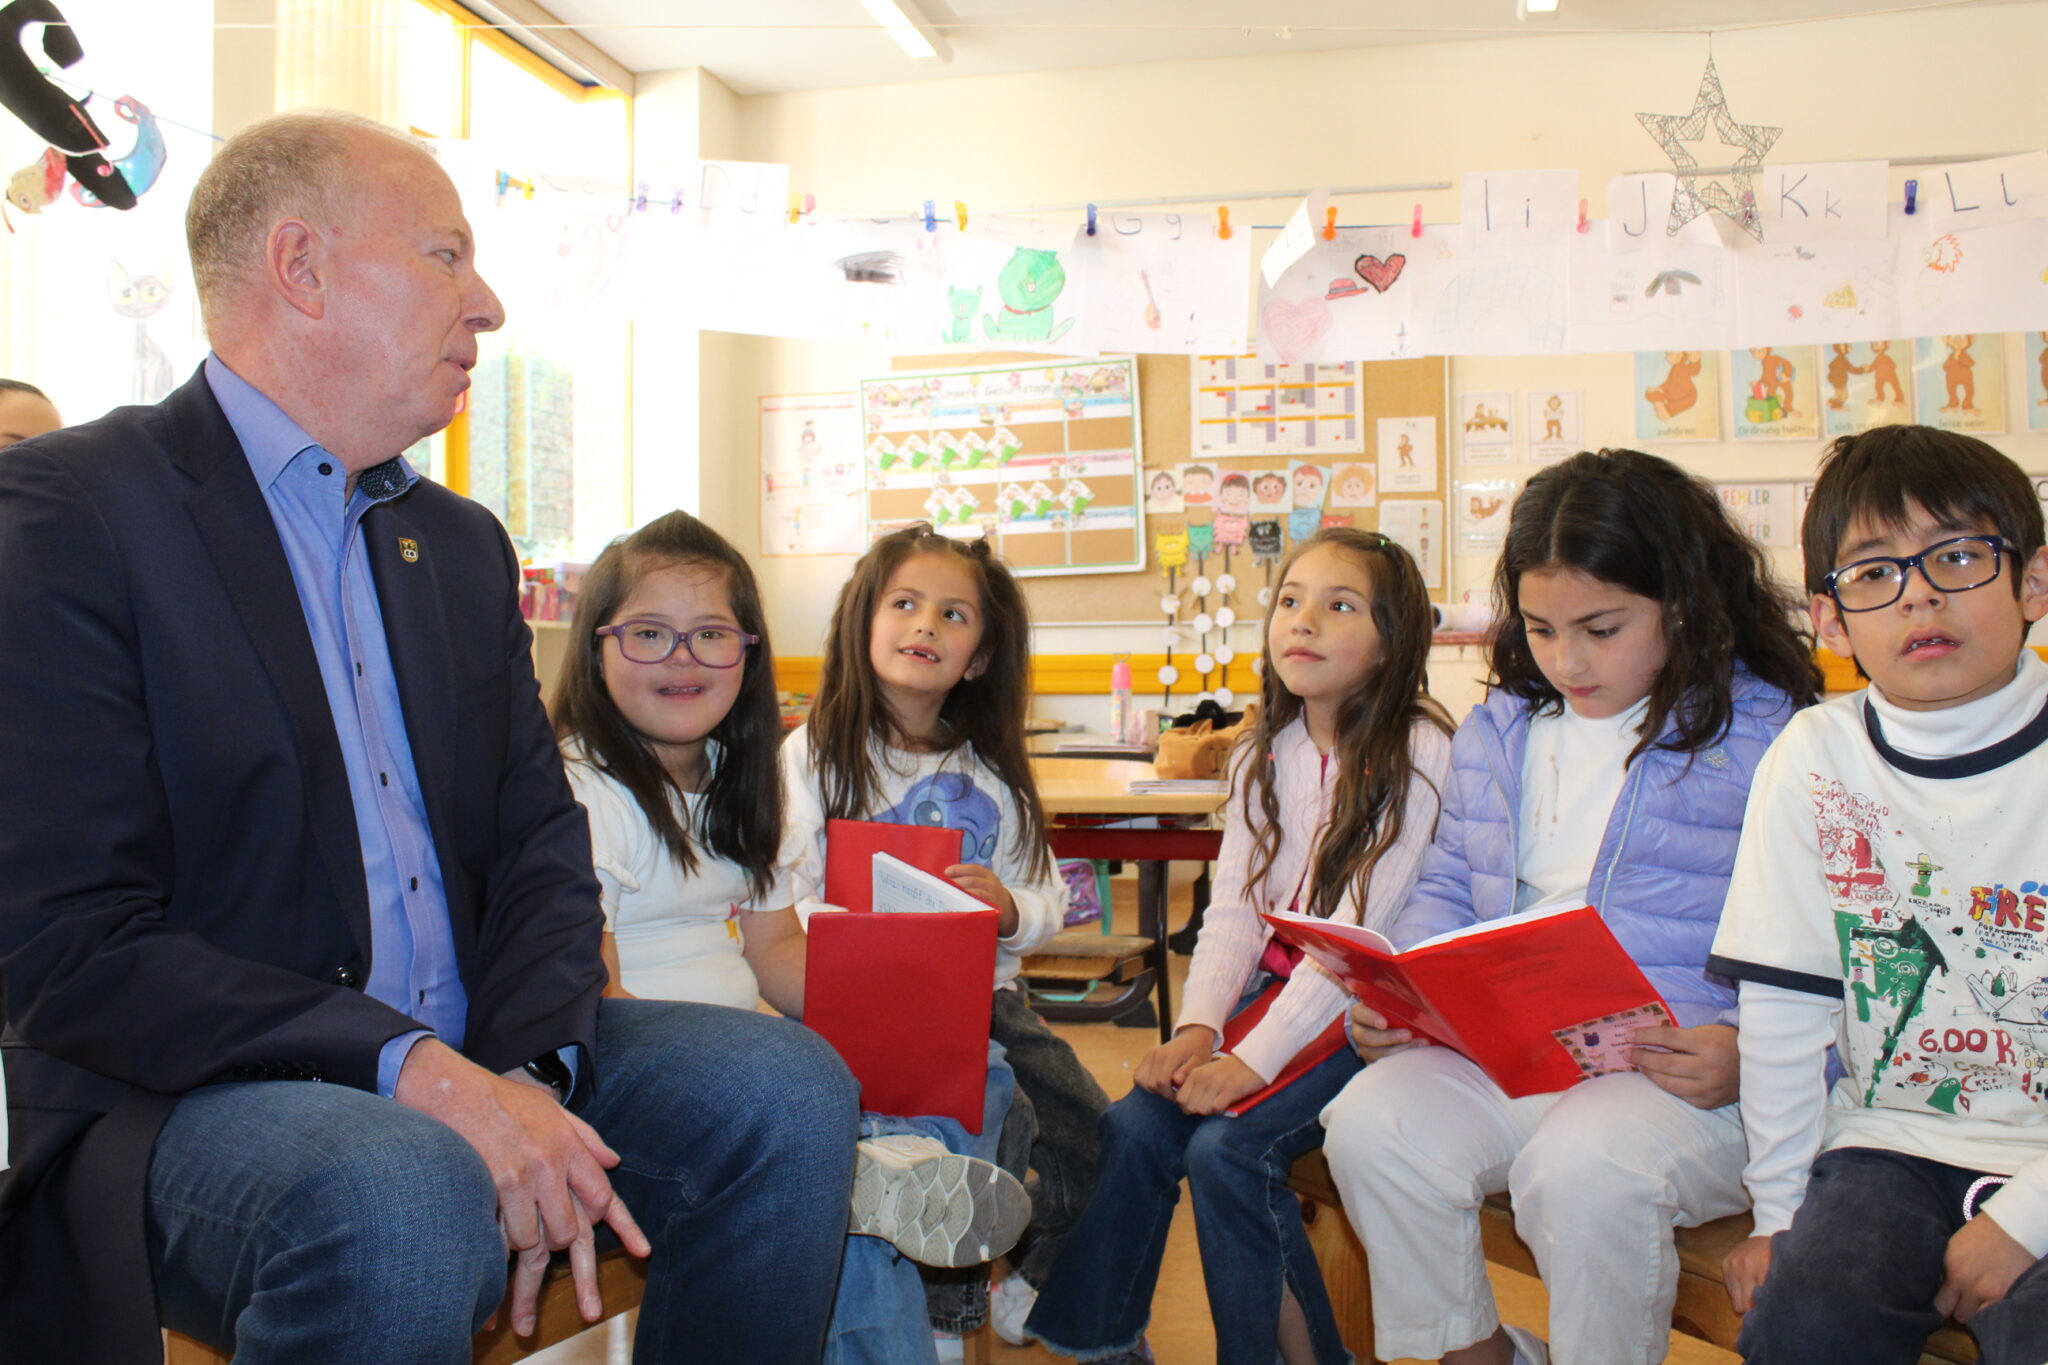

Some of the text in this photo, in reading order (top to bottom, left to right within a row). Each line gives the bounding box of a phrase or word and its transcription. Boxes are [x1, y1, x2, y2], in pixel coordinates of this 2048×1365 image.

[699, 164, 762, 214] D d
[1780, 172, 1841, 218] K k
[1945, 171, 1980, 212] L
[1525, 197, 1531, 229] i
[1623, 180, 1647, 236] J
[1111, 213, 1143, 236] G
[1656, 426, 1697, 437] zuhören
[1738, 426, 1781, 438] Ordnung
[1939, 418, 1985, 429] leise sein
[1721, 488, 1770, 505] FEHLER
[1918, 1028, 1988, 1054] 6,00
